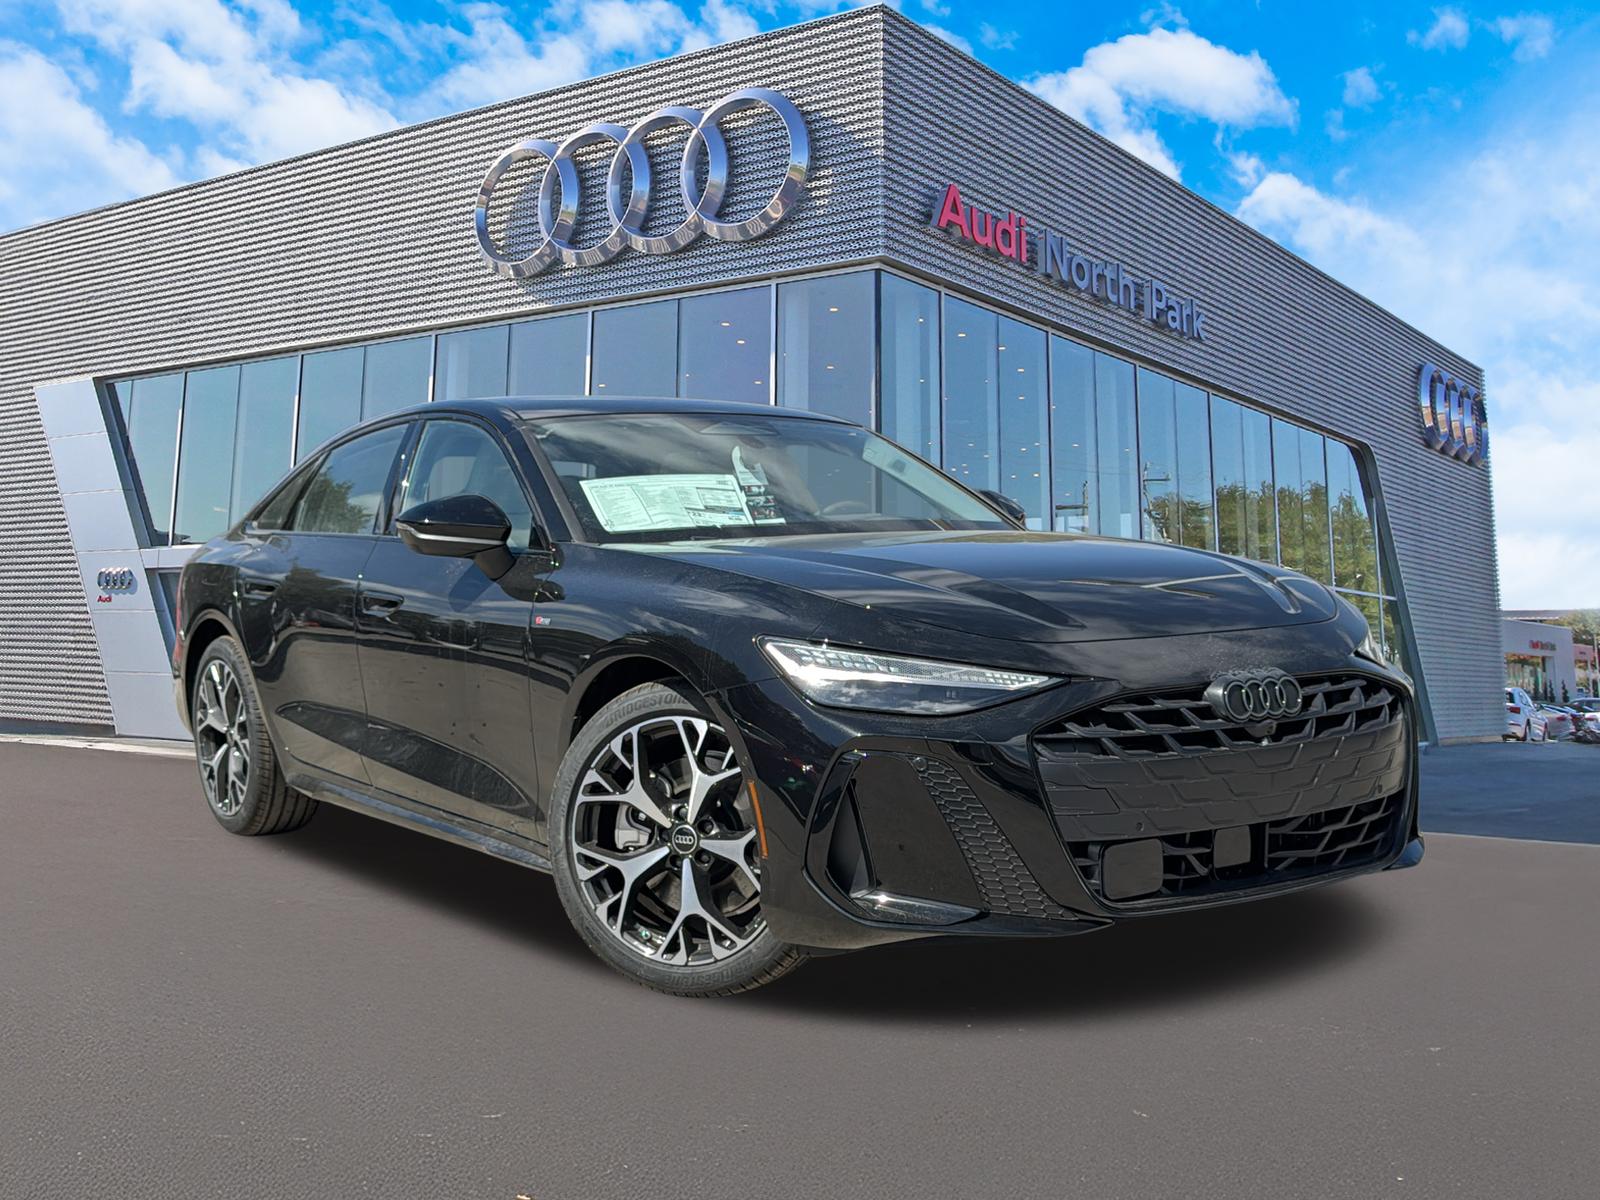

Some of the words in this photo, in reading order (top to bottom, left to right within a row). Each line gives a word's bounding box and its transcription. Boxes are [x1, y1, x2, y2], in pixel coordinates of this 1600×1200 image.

[932, 183, 1028, 263] Audi
[1038, 229, 1137, 313] North
[1144, 278, 1207, 341] Park
